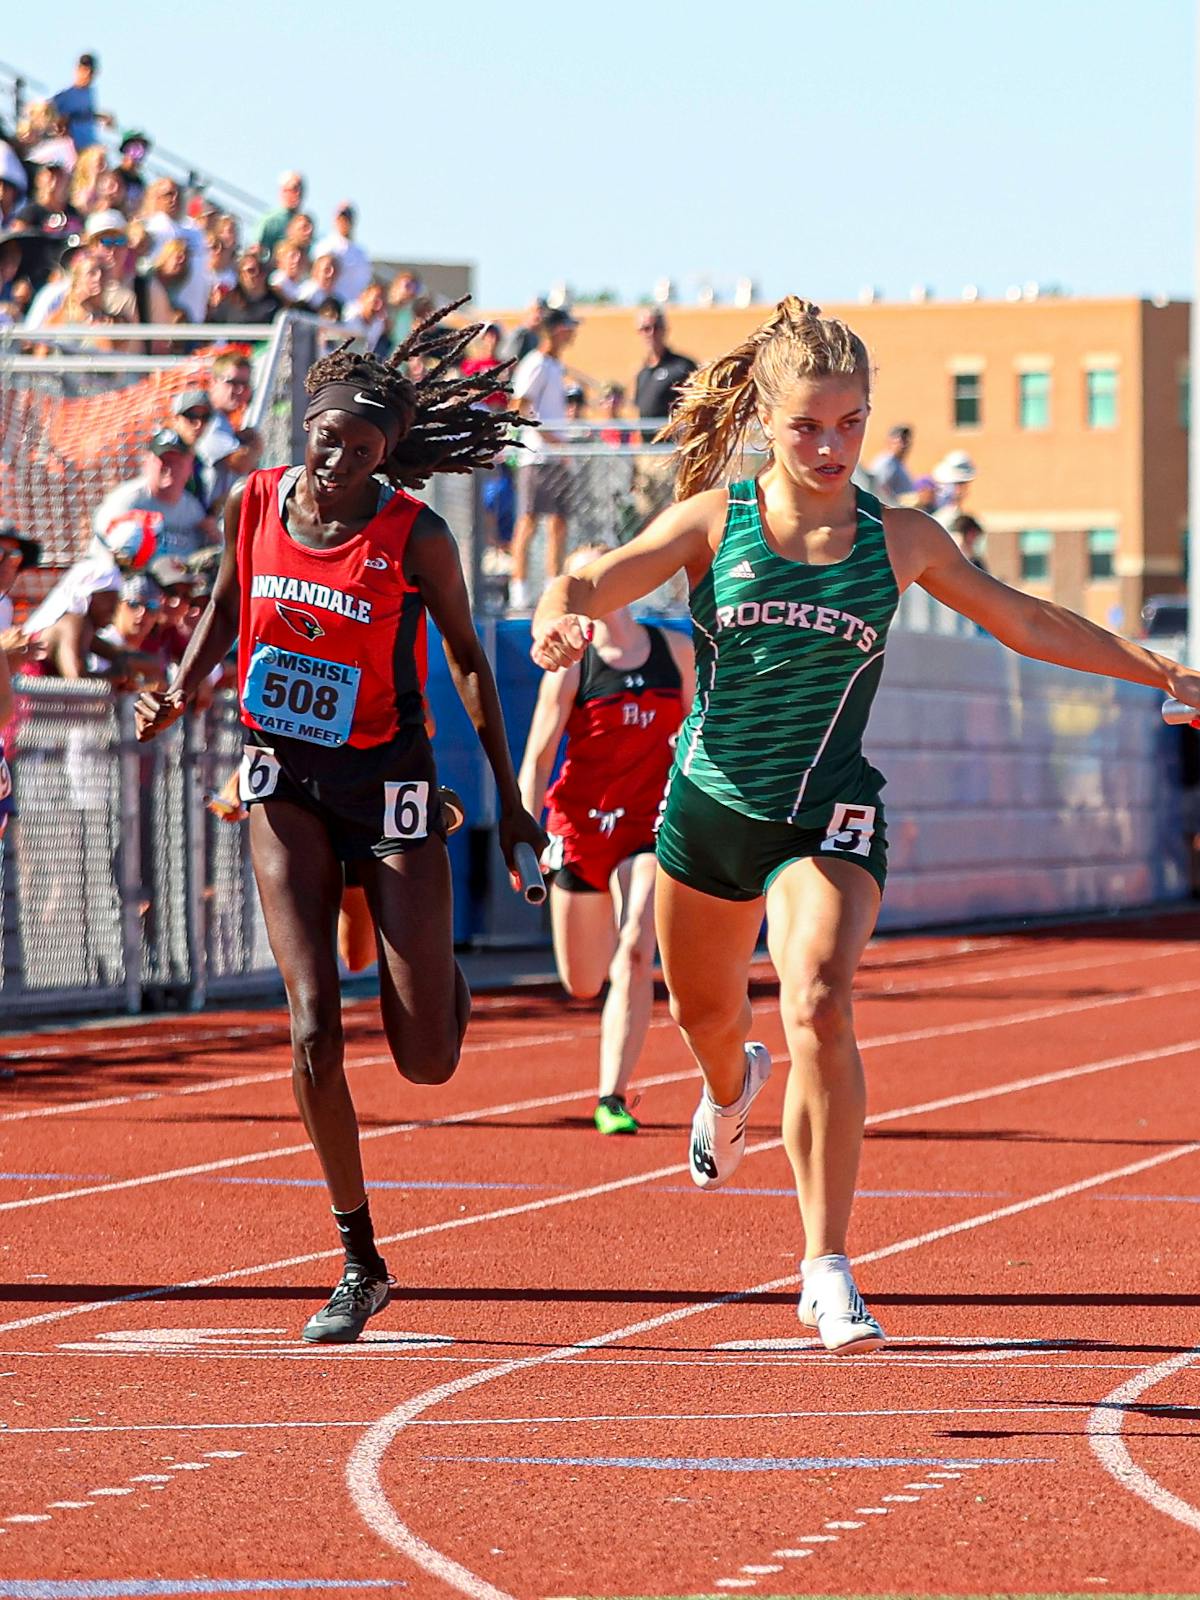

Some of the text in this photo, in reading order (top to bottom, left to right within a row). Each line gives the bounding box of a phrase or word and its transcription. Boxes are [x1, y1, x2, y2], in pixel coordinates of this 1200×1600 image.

[716, 601, 878, 653] ROCKETS
[276, 653, 354, 686] MSHSL
[262, 671, 339, 721] 508
[298, 724, 342, 745] MEET
[248, 749, 270, 795] 6
[394, 783, 420, 835] 6
[833, 809, 866, 850] 5
